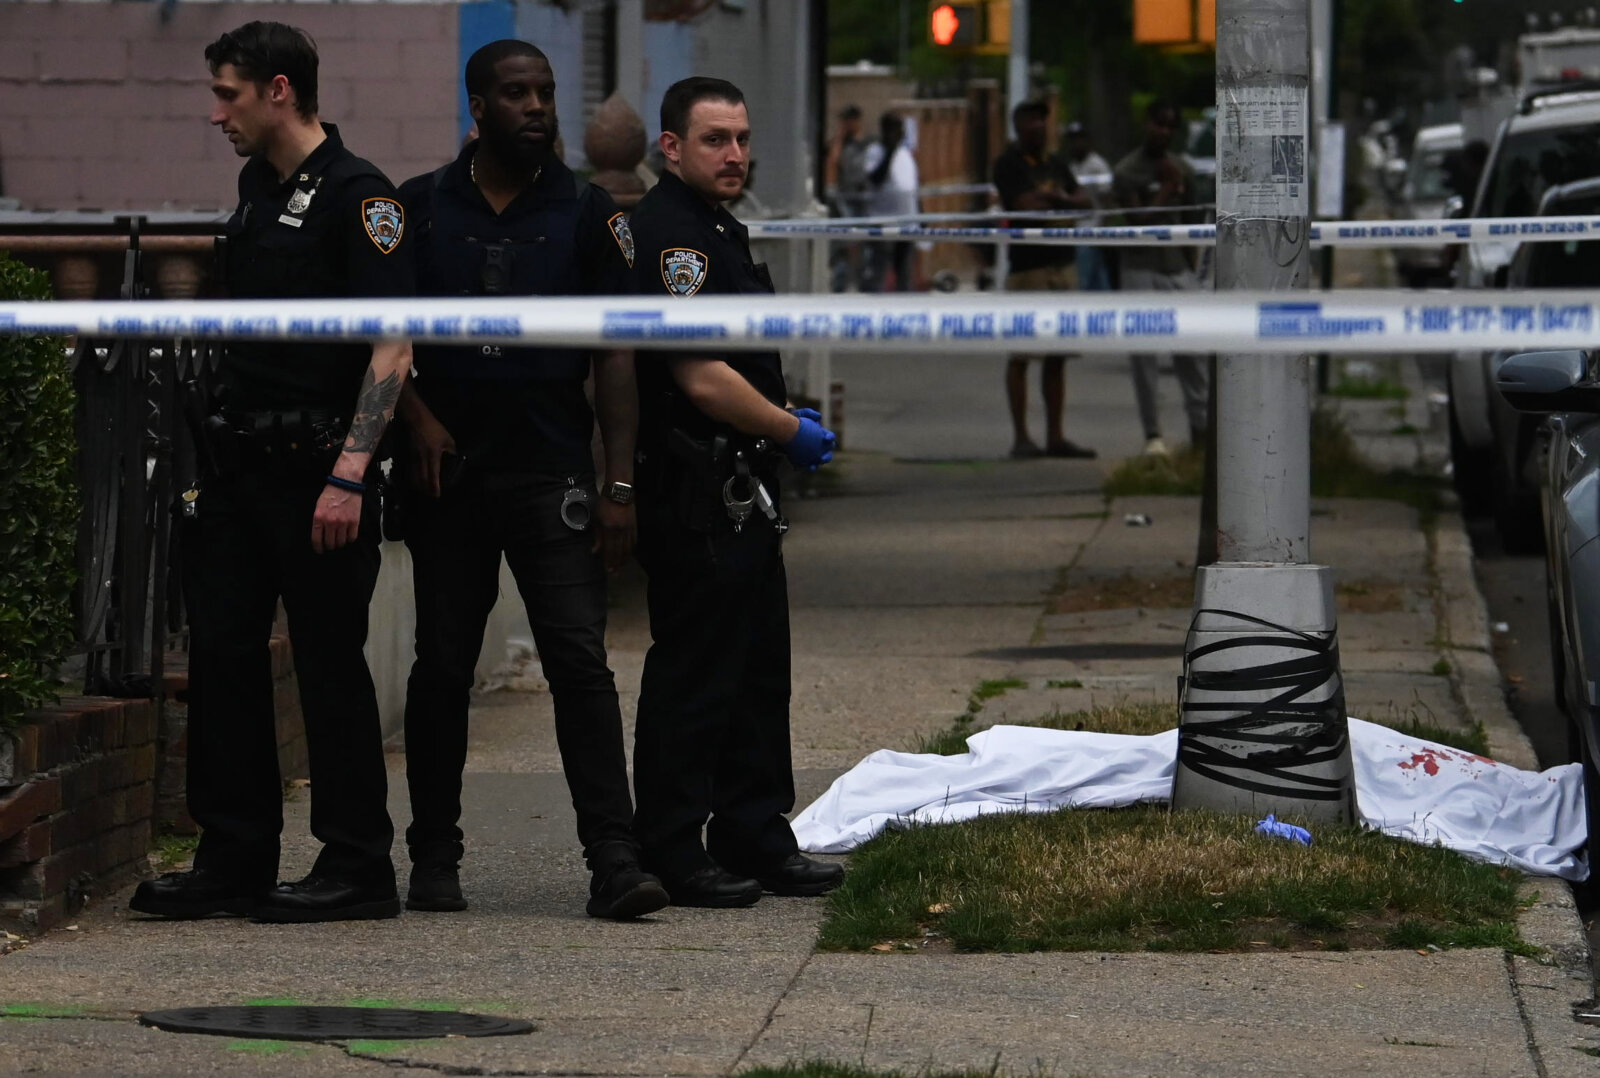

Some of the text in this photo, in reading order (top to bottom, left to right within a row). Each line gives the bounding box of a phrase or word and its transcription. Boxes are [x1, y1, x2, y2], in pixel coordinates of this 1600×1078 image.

[374, 201, 395, 211] POLICE
[366, 207, 401, 219] DEPARTMENT
[674, 251, 697, 260] POLICE
[665, 256, 704, 268] DEPARTMENT
[664, 270, 678, 292] CITY OF
[941, 312, 995, 338] POLICE
[1002, 312, 1036, 338] LINE
[1058, 310, 1080, 336] DO
[1086, 310, 1117, 336] NOT
[1123, 309, 1178, 336] CROSS
